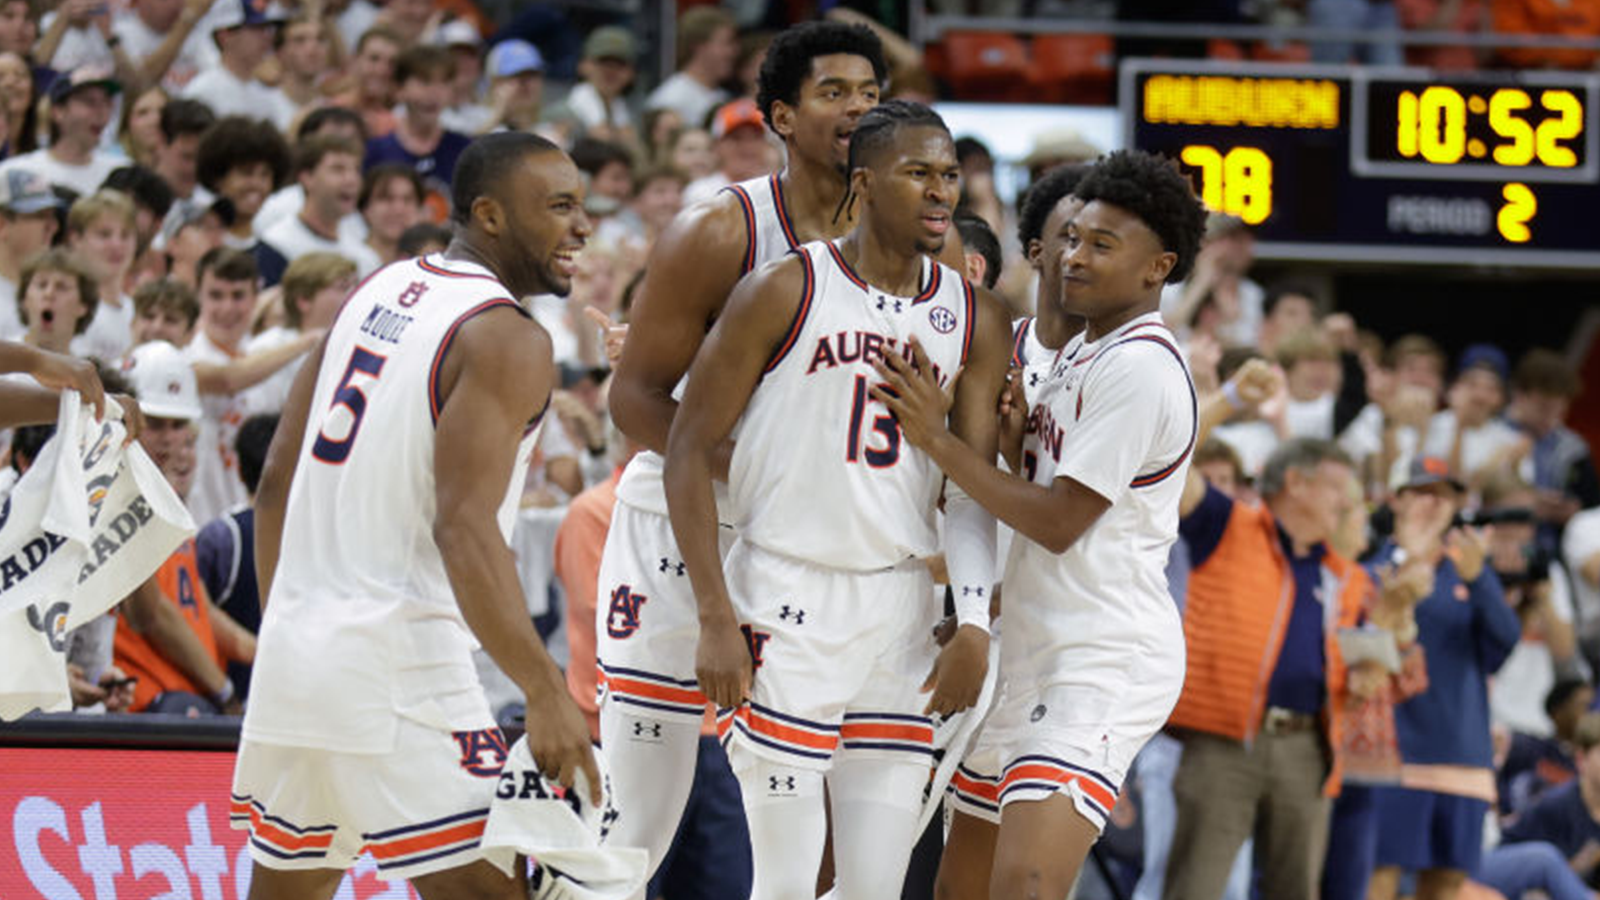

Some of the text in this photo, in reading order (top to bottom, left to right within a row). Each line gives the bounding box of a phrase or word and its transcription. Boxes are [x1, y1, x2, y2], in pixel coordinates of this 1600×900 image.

[1397, 86, 1584, 168] 10:52
[1181, 145, 1273, 225] 78
[1497, 183, 1537, 242] 2
[312, 345, 388, 465] 5
[846, 373, 902, 469] 13
[496, 770, 561, 800] GA
[12, 796, 254, 900] Stat
